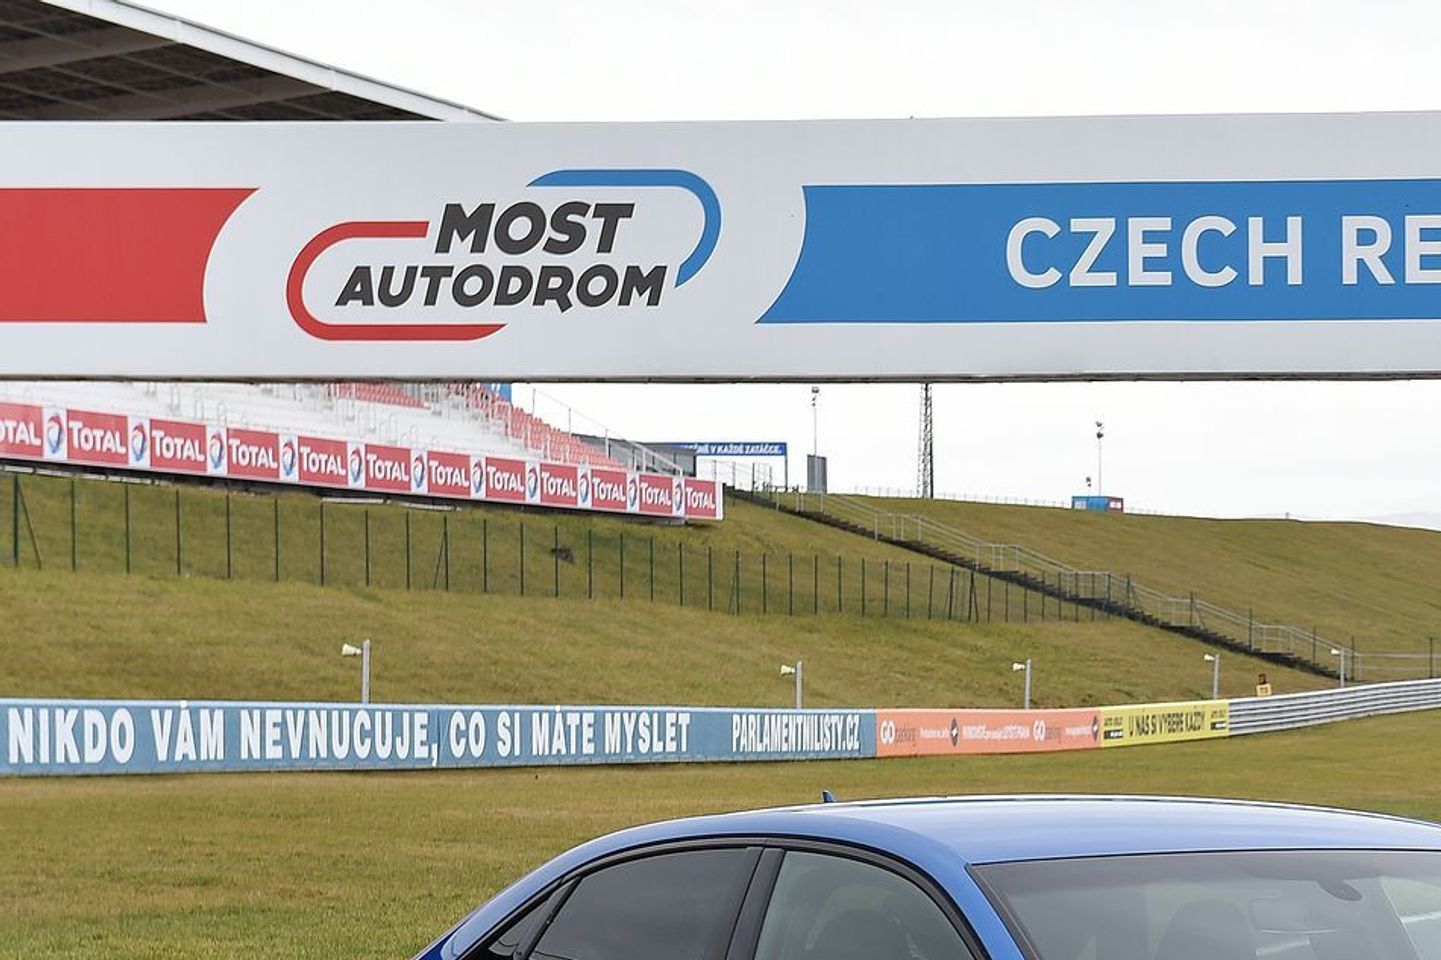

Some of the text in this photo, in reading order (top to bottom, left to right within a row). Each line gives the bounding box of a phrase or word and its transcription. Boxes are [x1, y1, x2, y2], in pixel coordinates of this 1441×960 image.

[434, 202, 635, 254] MOST
[1005, 215, 1303, 289] CZECH
[334, 263, 668, 313] AUTODROM
[68, 420, 127, 454] TOTAL
[152, 429, 205, 462] TOTAL
[228, 438, 278, 469] TOTAL
[300, 445, 347, 476] TOTAL
[366, 453, 410, 482] TOTAL
[428, 459, 470, 487] TOTAL
[486, 466, 524, 493] TOTAL
[541, 471, 577, 498] TOTAL
[592, 476, 626, 502] TOTAL
[639, 482, 672, 507] TOTAL
[685, 486, 716, 511] TOTAL
[8, 707, 135, 764] NIKDO
[240, 709, 438, 767] NEVNUCUJE,
[450, 711, 486, 758] CO
[497, 711, 520, 757] SI
[605, 712, 690, 754] MYSLET
[732, 714, 860, 752] PARLAMENTNILISTY.CZ
[880, 719, 895, 744] GO
